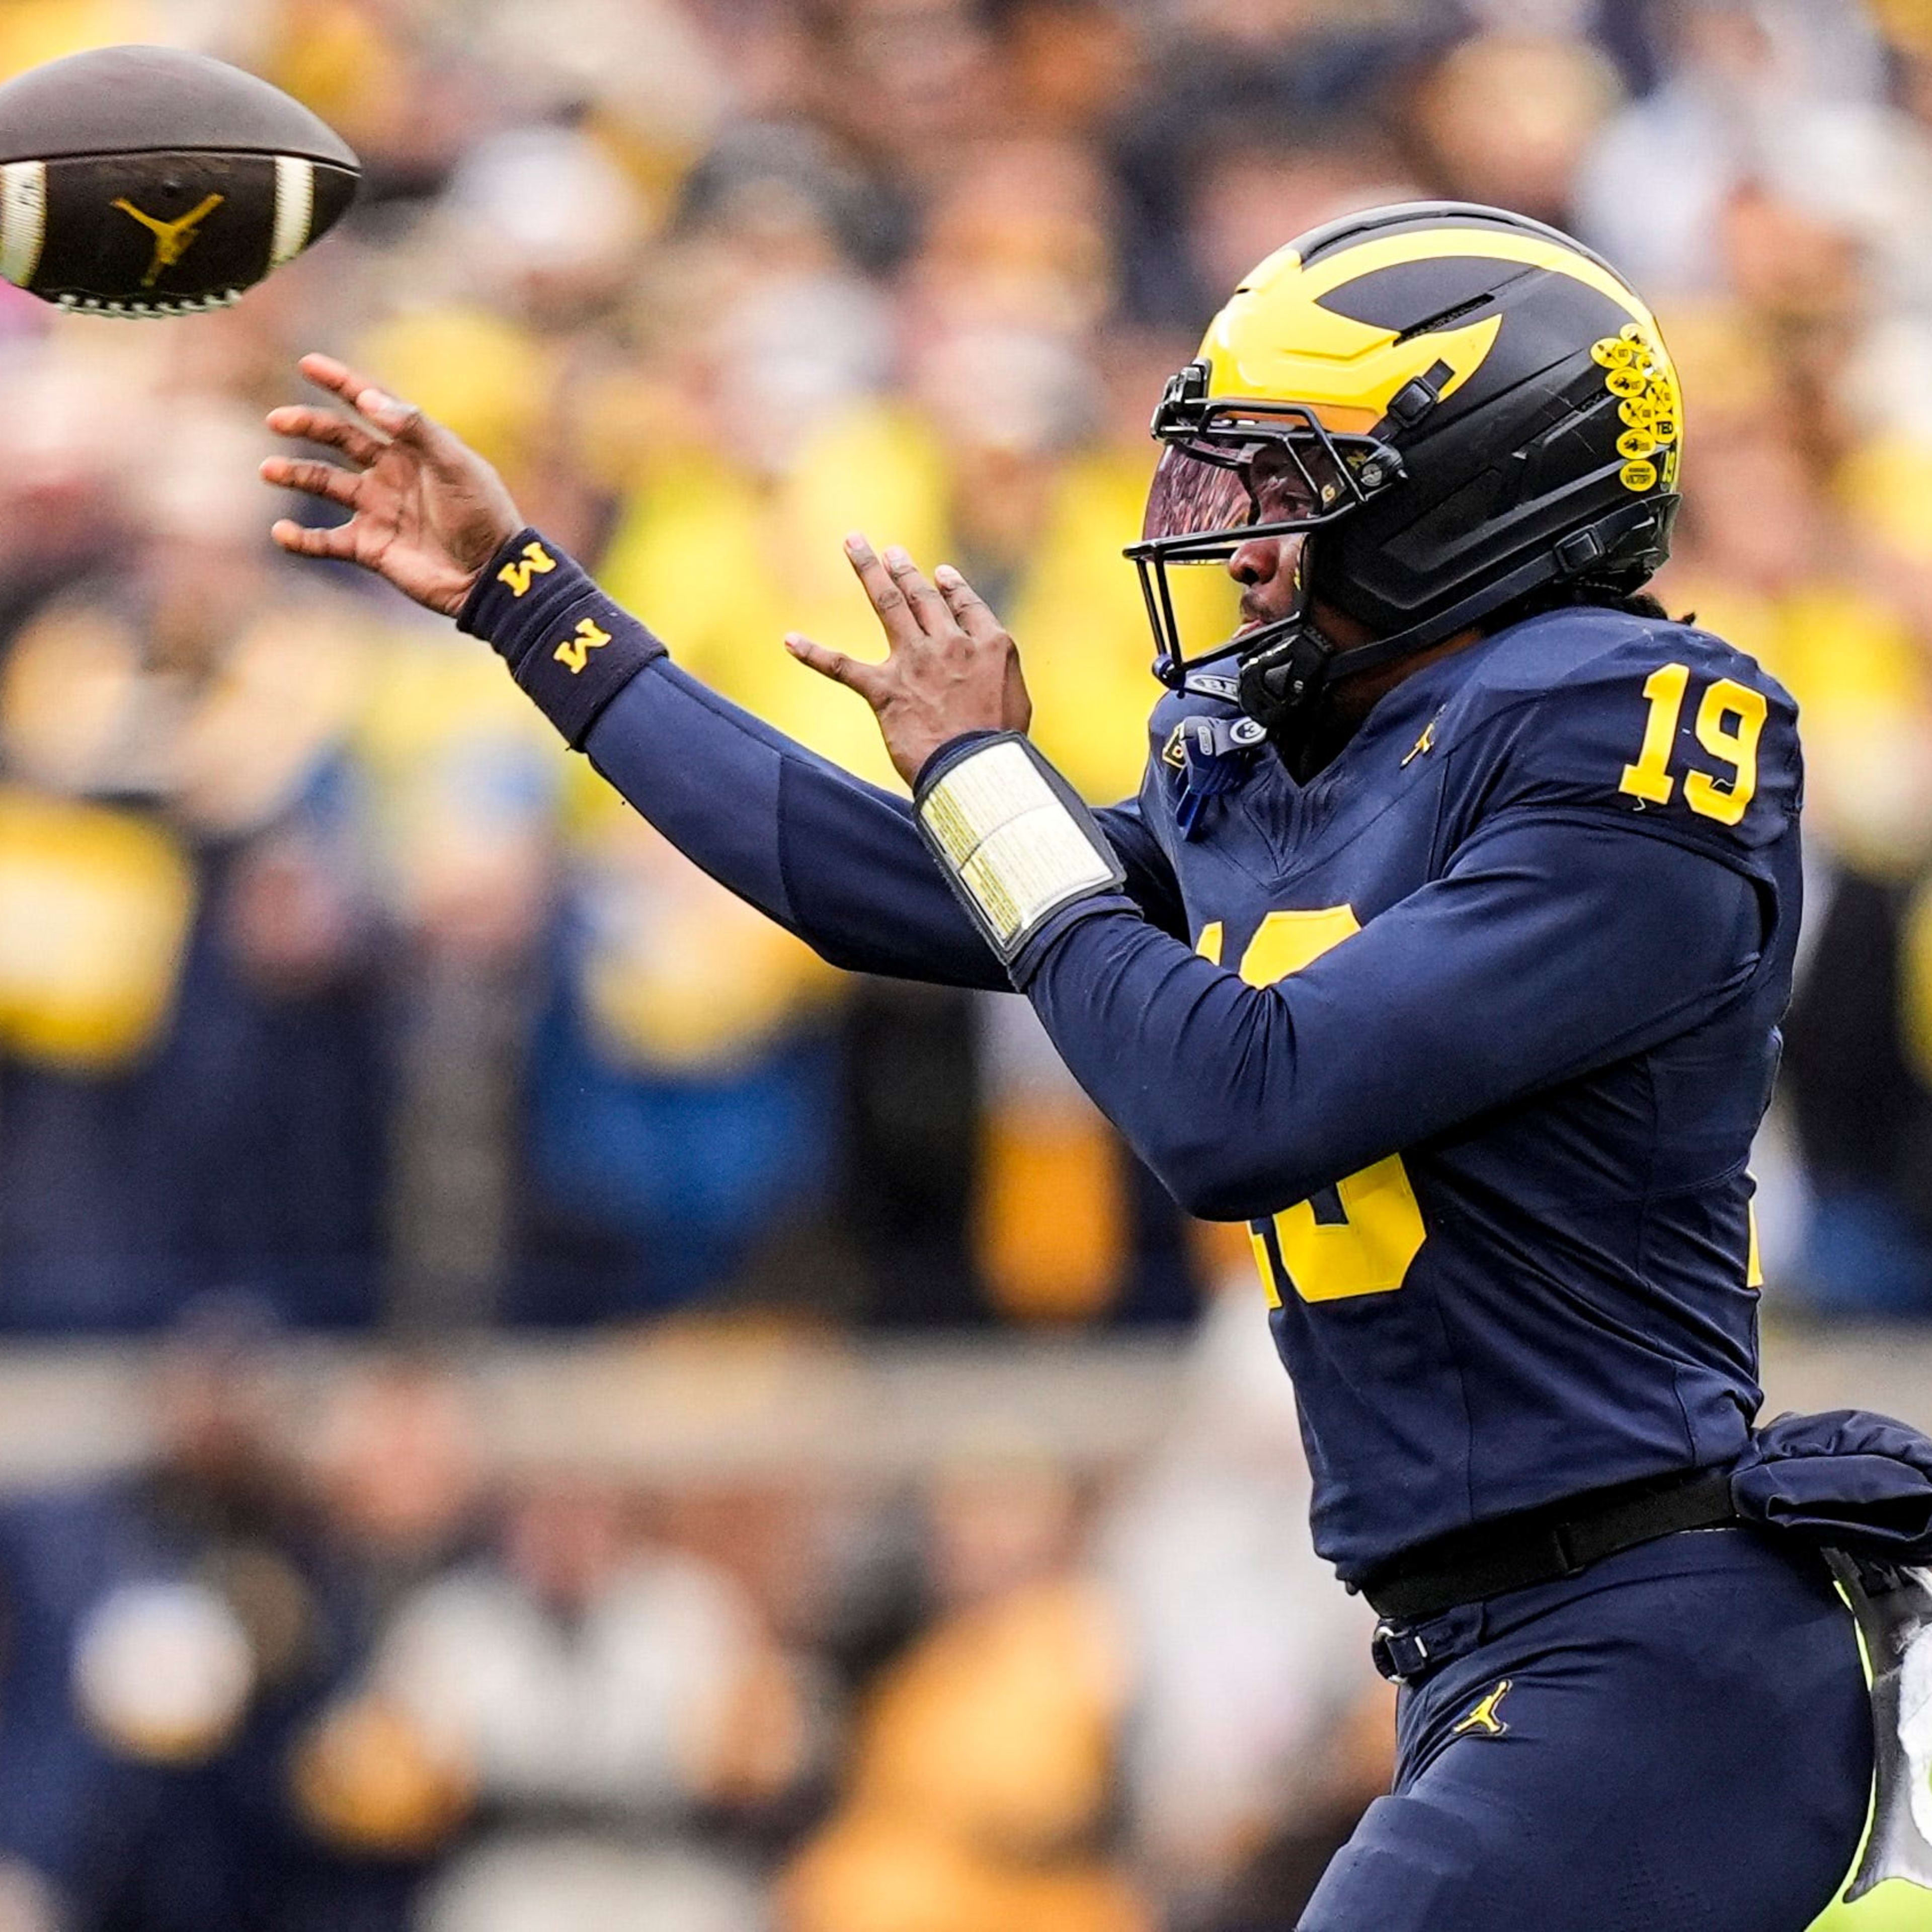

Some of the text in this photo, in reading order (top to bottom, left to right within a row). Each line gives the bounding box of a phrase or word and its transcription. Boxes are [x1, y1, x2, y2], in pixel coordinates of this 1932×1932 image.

[497, 542, 556, 597] M
[554, 618, 612, 674] M
[1619, 663, 1767, 826] 19
